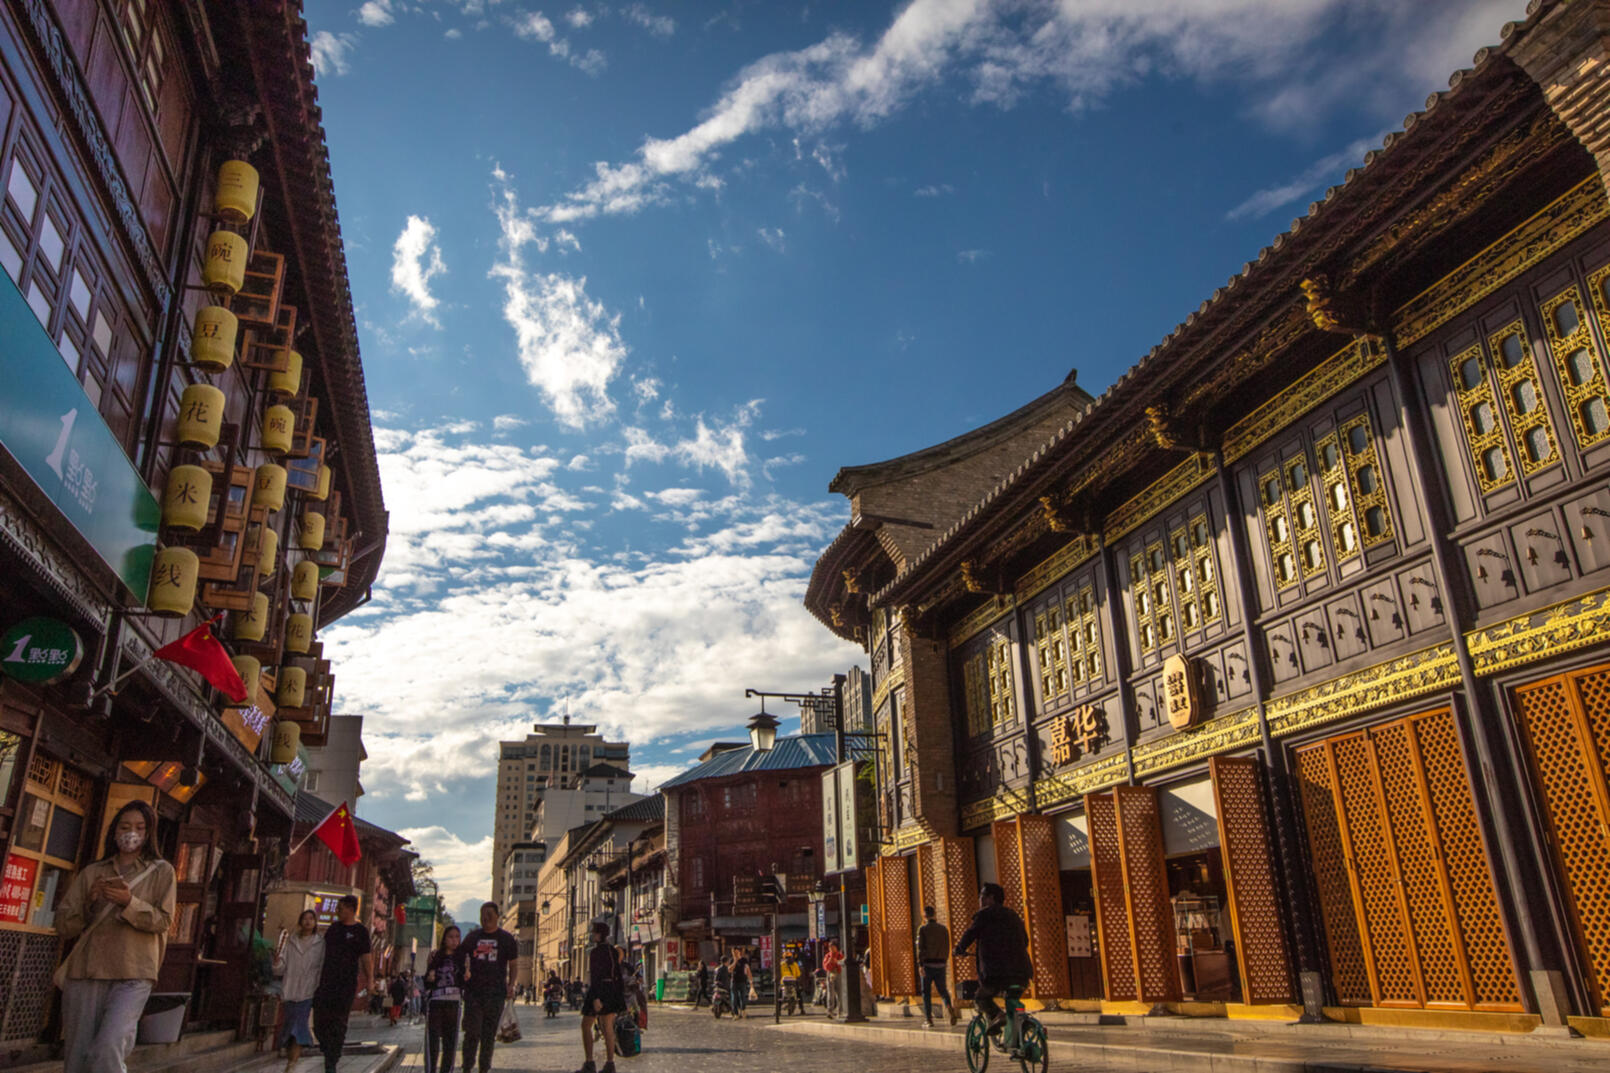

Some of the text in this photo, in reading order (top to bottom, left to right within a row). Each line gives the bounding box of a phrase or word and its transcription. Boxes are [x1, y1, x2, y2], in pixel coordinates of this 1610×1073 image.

[221, 171, 244, 189] 三
[211, 241, 233, 263] 碗
[200, 320, 223, 341] 豆
[184, 400, 208, 424] 花
[175, 482, 199, 506] 米
[153, 564, 183, 590] 线
[1048, 703, 1099, 768] 嘉华
